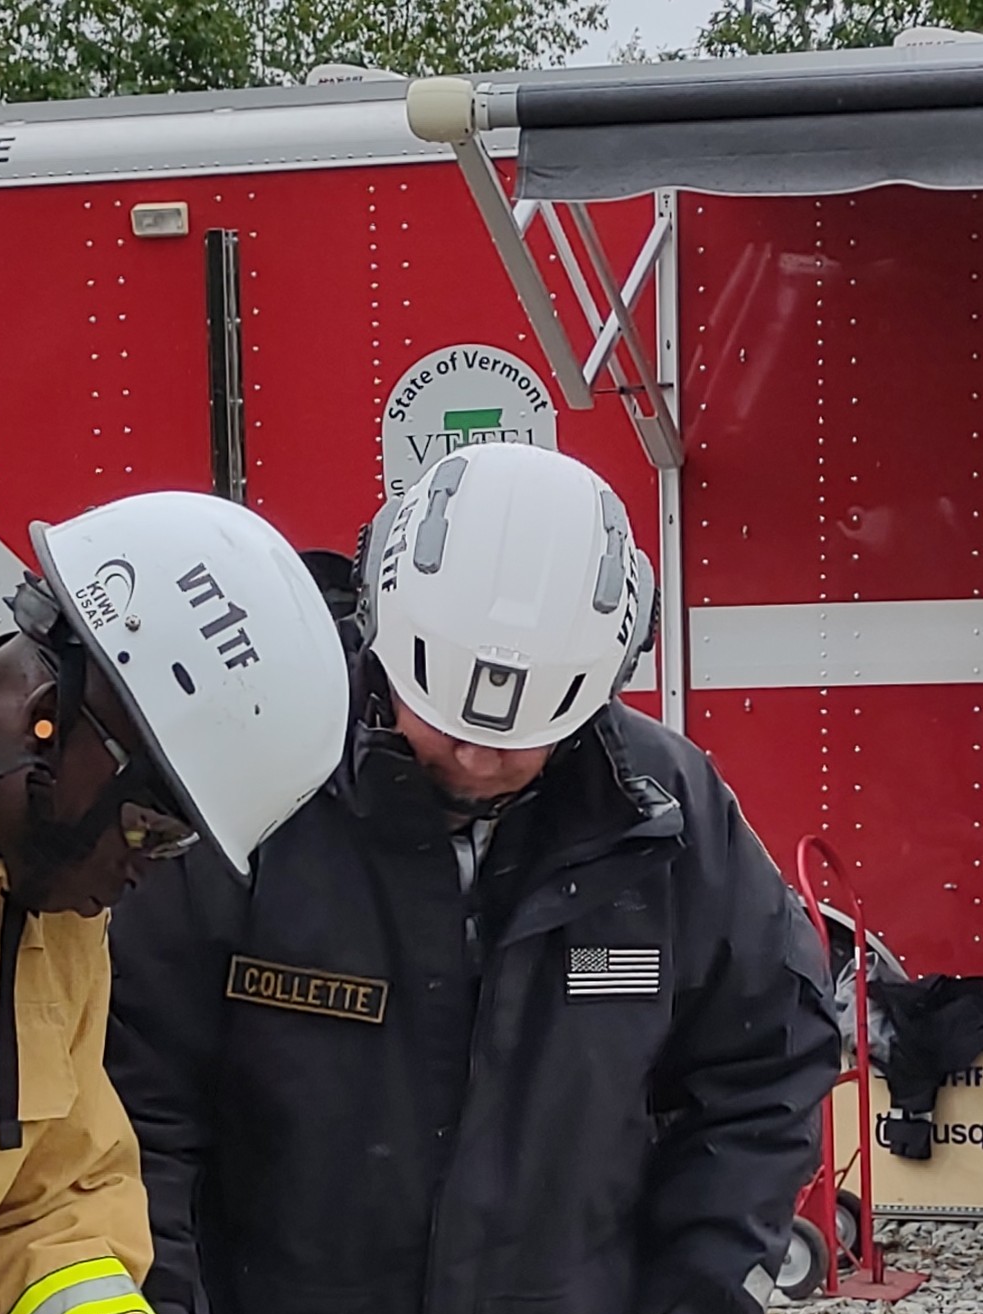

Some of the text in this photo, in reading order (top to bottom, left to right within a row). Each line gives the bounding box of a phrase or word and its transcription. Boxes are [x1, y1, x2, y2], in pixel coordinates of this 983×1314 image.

[388, 350, 548, 422] State of Vermont
[75, 589, 104, 630] USAR
[86, 580, 119, 623] KIWI
[244, 967, 373, 1012] COLLETTE
